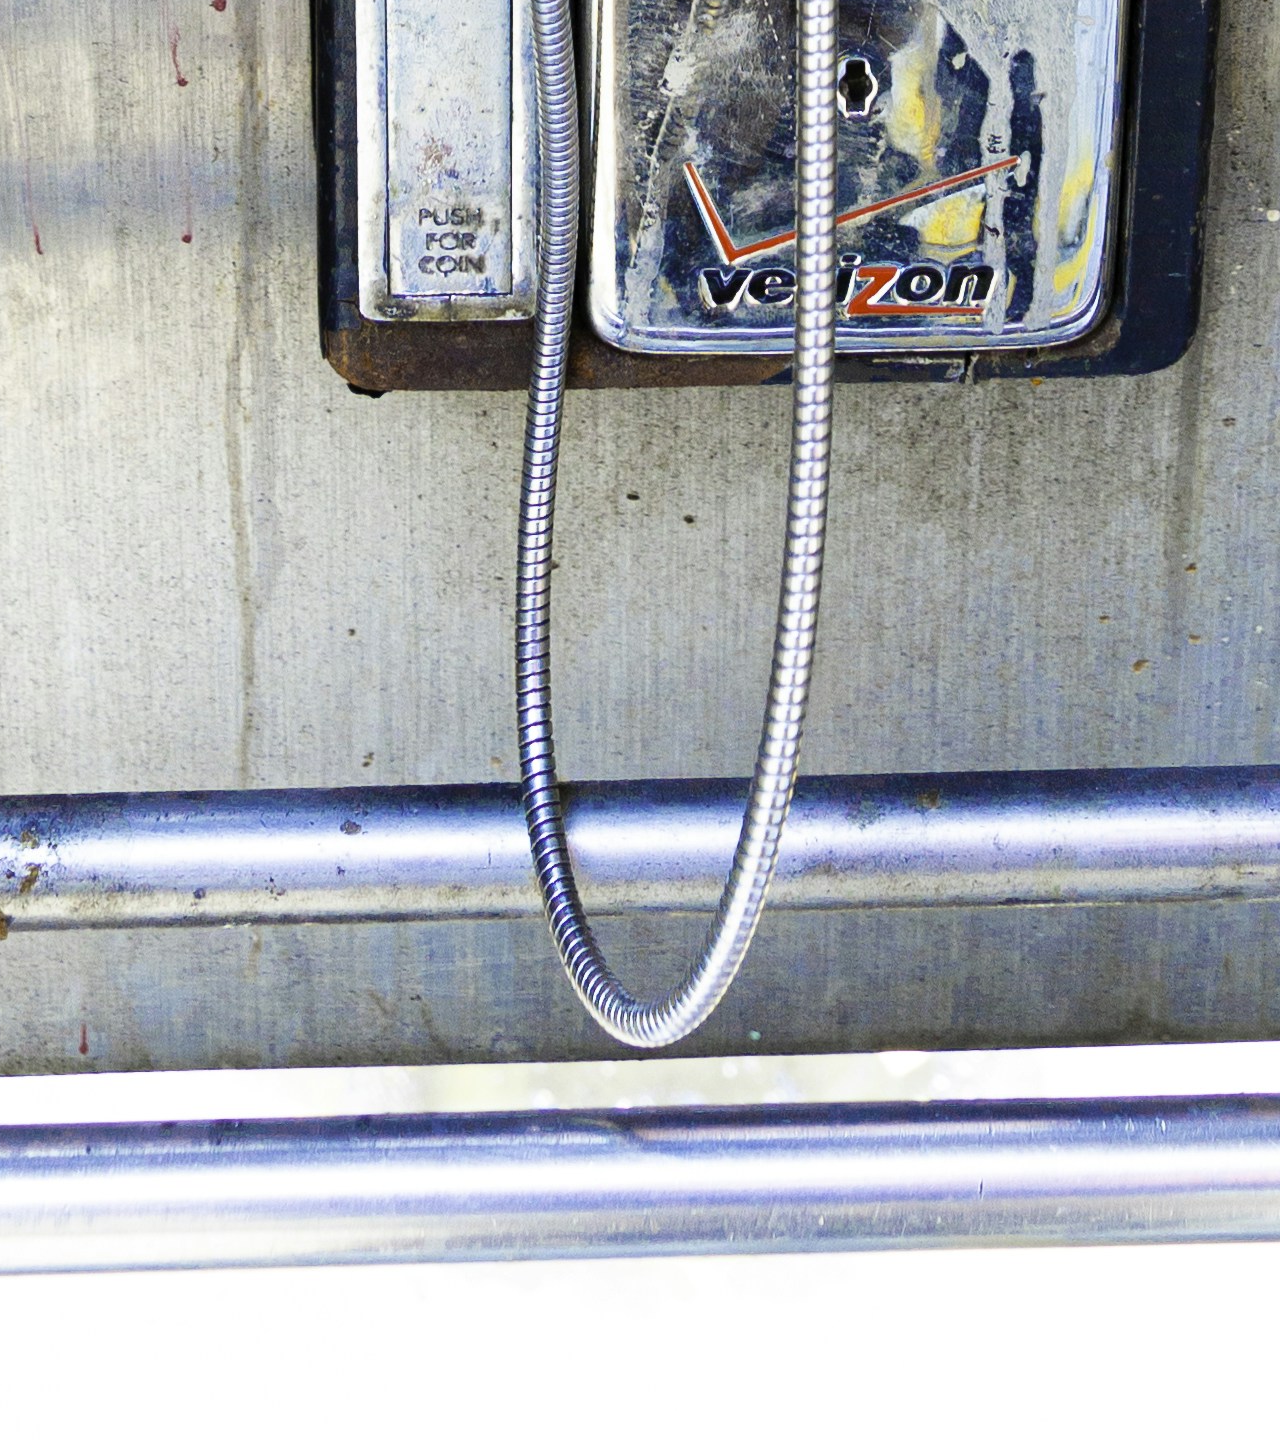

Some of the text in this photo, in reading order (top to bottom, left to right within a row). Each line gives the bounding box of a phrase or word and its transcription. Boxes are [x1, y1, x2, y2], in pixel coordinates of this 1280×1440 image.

[418, 207, 484, 228] PUSH
[426, 232, 477, 251] FOR
[418, 255, 485, 277] COIN
[698, 251, 998, 318] veizon
